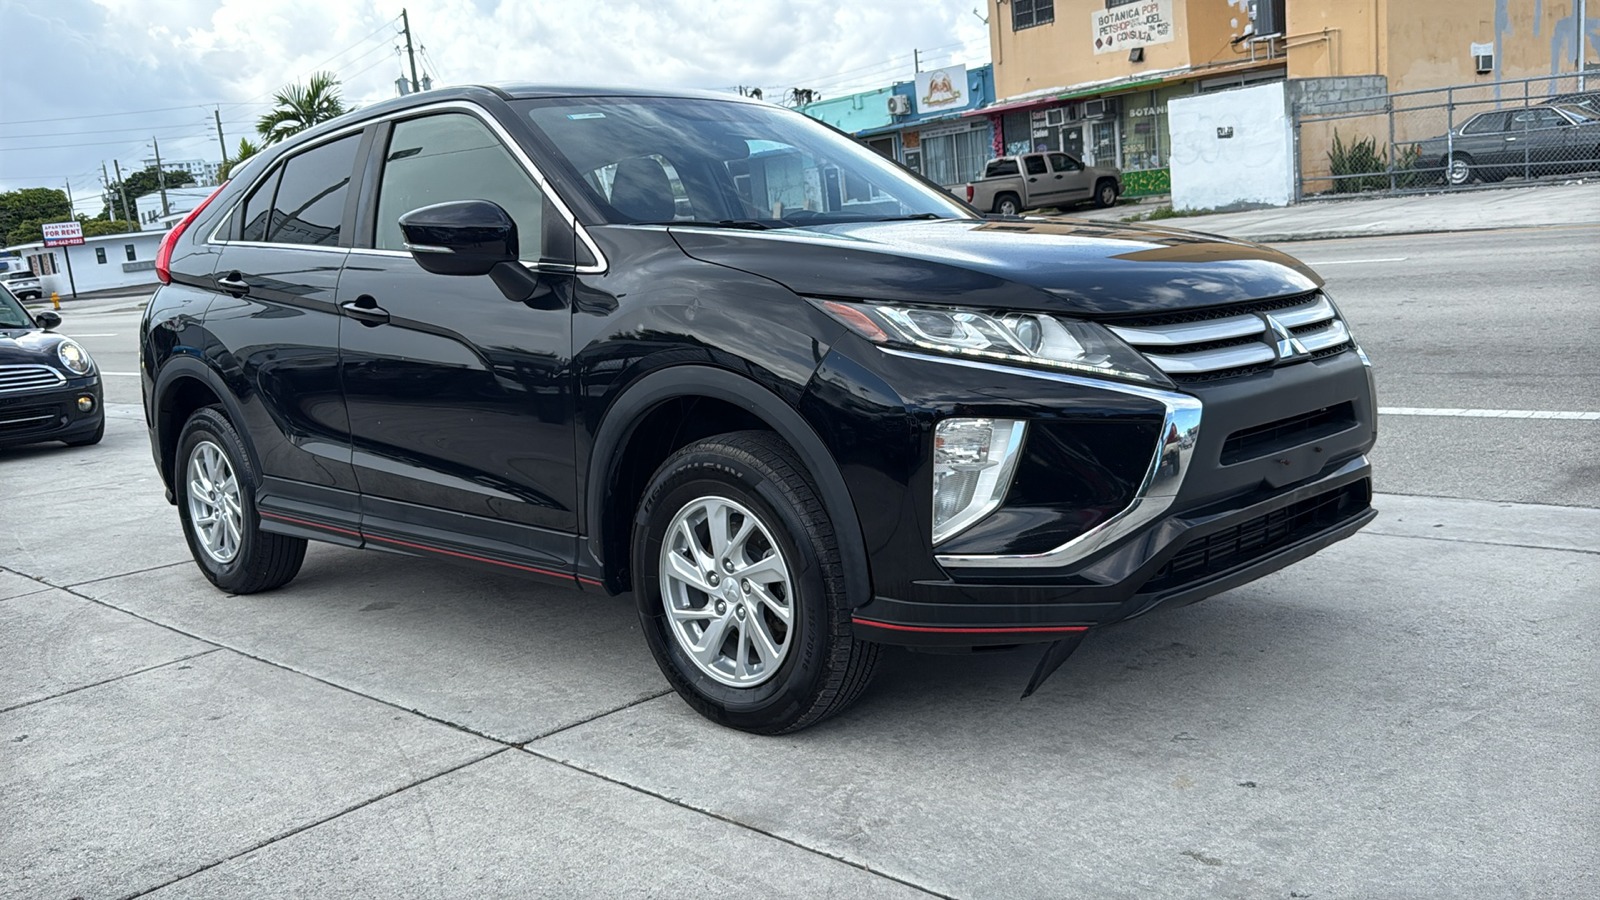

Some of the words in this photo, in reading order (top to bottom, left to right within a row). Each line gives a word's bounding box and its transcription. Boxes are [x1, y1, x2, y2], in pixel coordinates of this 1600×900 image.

[1098, 8, 1140, 26] BOTANICA
[1141, 3, 1159, 15] POPI
[1033, 129, 1049, 139] Salon
[802, 607, 816, 671] 215/70R16
